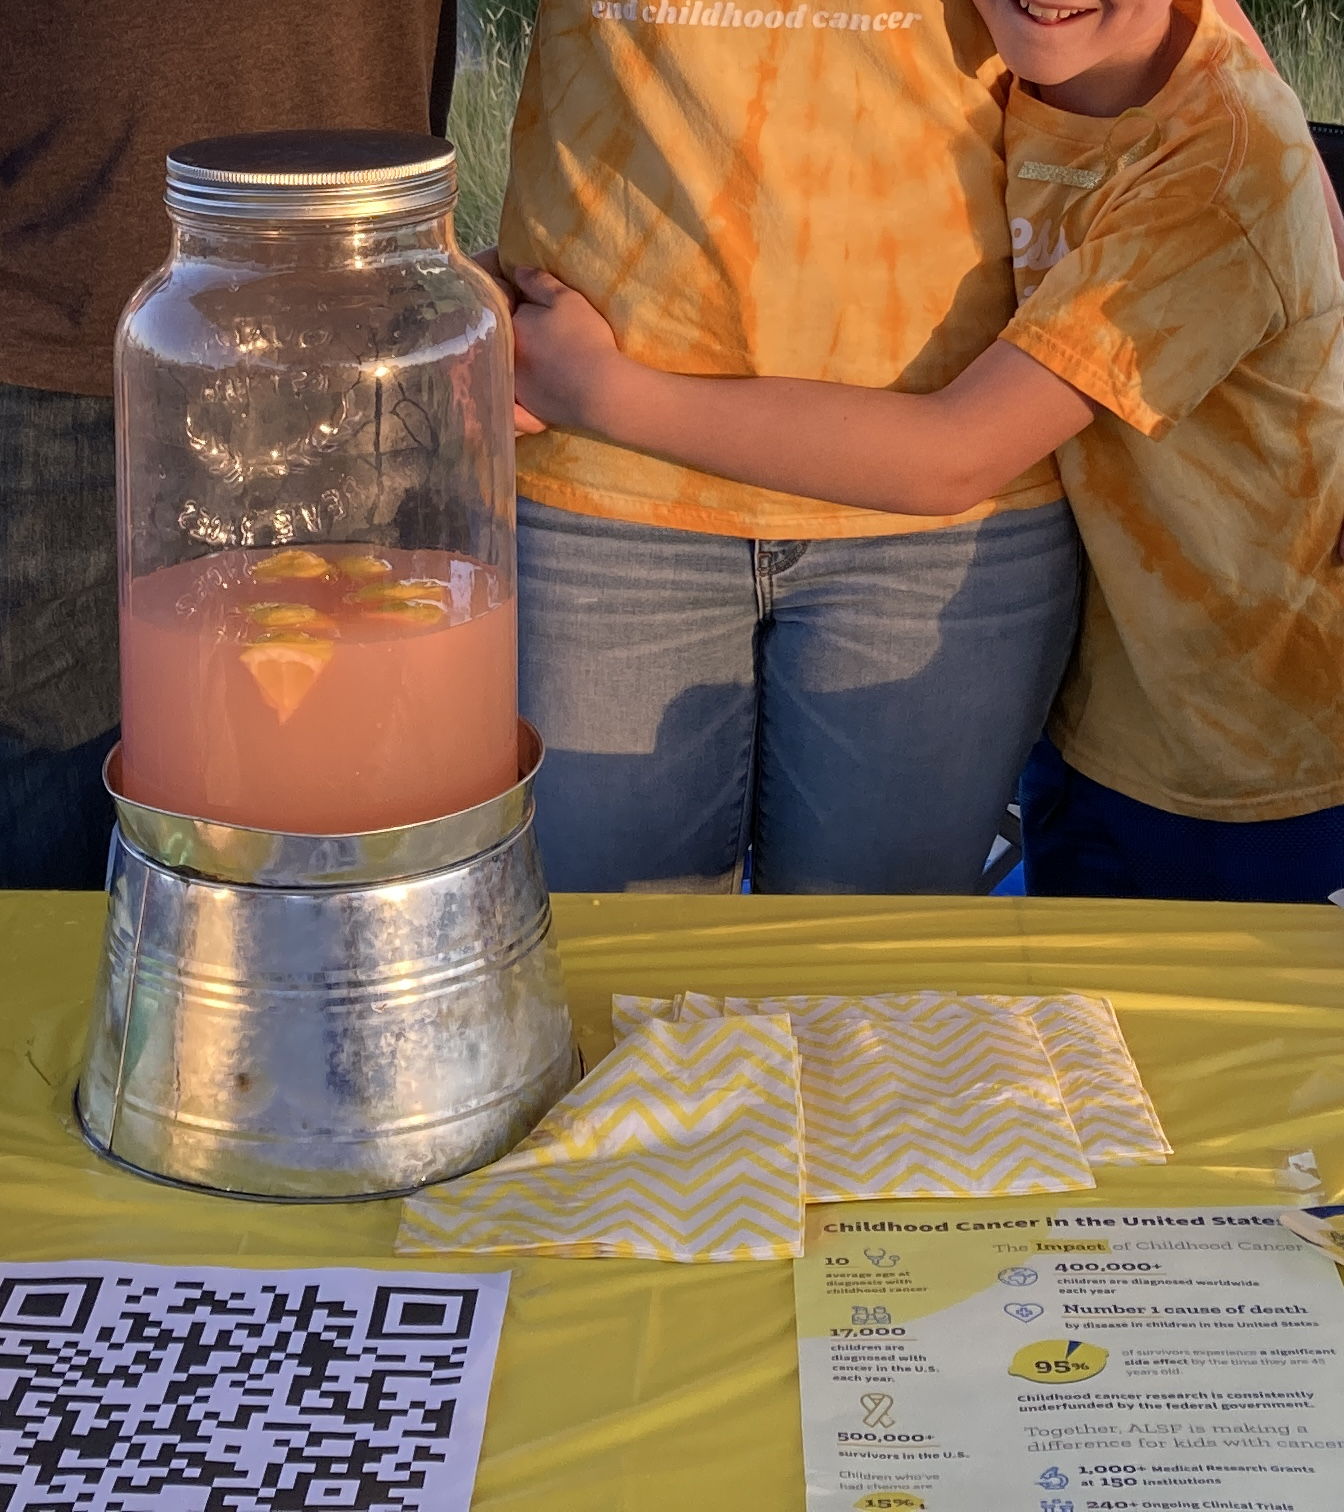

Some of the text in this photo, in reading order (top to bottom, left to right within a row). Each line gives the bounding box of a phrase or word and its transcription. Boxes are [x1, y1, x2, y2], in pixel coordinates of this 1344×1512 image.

[812, 10, 923, 33] cancer
[822, 1220, 949, 1234] Childhood
[956, 1217, 1039, 1232] Cancer
[1045, 1215, 1069, 1228] in
[1075, 1215, 1116, 1228] the
[1122, 1214, 1205, 1228] United
[992, 1240, 1304, 1254] The Impact of Childhood Cancer
[824, 1256, 849, 1266] 10
[1054, 1261, 1162, 1273] 400,000+
[1057, 1277, 1107, 1286] children
[1131, 1277, 1193, 1287] diagnosed
[1195, 1279, 1260, 1287] worldwide
[826, 1287, 887, 1295] childhood
[1058, 1287, 1117, 1296] each year
[1063, 1303, 1310, 1315] Number 1 cause of death
[1065, 1320, 1320, 1330] by disease in children in the United States
[829, 1327, 906, 1338] 17,000
[831, 1354, 927, 1363] diagnosed with
[1122, 1348, 1134, 1356] of
[1136, 1349, 1191, 1357] survivors
[1193, 1349, 1257, 1358] experience
[1269, 1348, 1336, 1357] significant
[875, 1364, 889, 1372] in
[891, 1364, 912, 1373] the
[913, 1364, 940, 1373] U.S.
[1034, 1359, 1090, 1375] 95%
[1124, 1358, 1150, 1366] side
[1152, 1358, 1189, 1366] effect
[1191, 1358, 1206, 1368] by
[1208, 1358, 1230, 1366] the
[1231, 1358, 1258, 1366] time
[1260, 1358, 1288, 1367] they
[832, 1374, 896, 1384] each year.
[1126, 1369, 1155, 1378] years
[1017, 1390, 1315, 1403] Childhood cancer research is consistently
[1019, 1401, 1315, 1413] underfunded by the federal government.
[1024, 1422, 1309, 1439] Together, ALSF is making a
[837, 1431, 935, 1443] 500,000+
[1027, 1438, 1132, 1453] difference
[1137, 1437, 1169, 1449] for
[1173, 1436, 1218, 1449] kids
[1223, 1437, 1271, 1448] with
[838, 1451, 971, 1460] survivors in the U.S.
[1078, 1464, 1316, 1475] 1,000+ Medical Research Grants
[839, 1470, 940, 1481] Children who've
[839, 1482, 864, 1490] had
[1080, 1476, 1222, 1488] at 150 Institutions
[864, 1498, 915, 1508] 15%
[1086, 1500, 1294, 1512] 240+ Ongoing Clinical Trials
